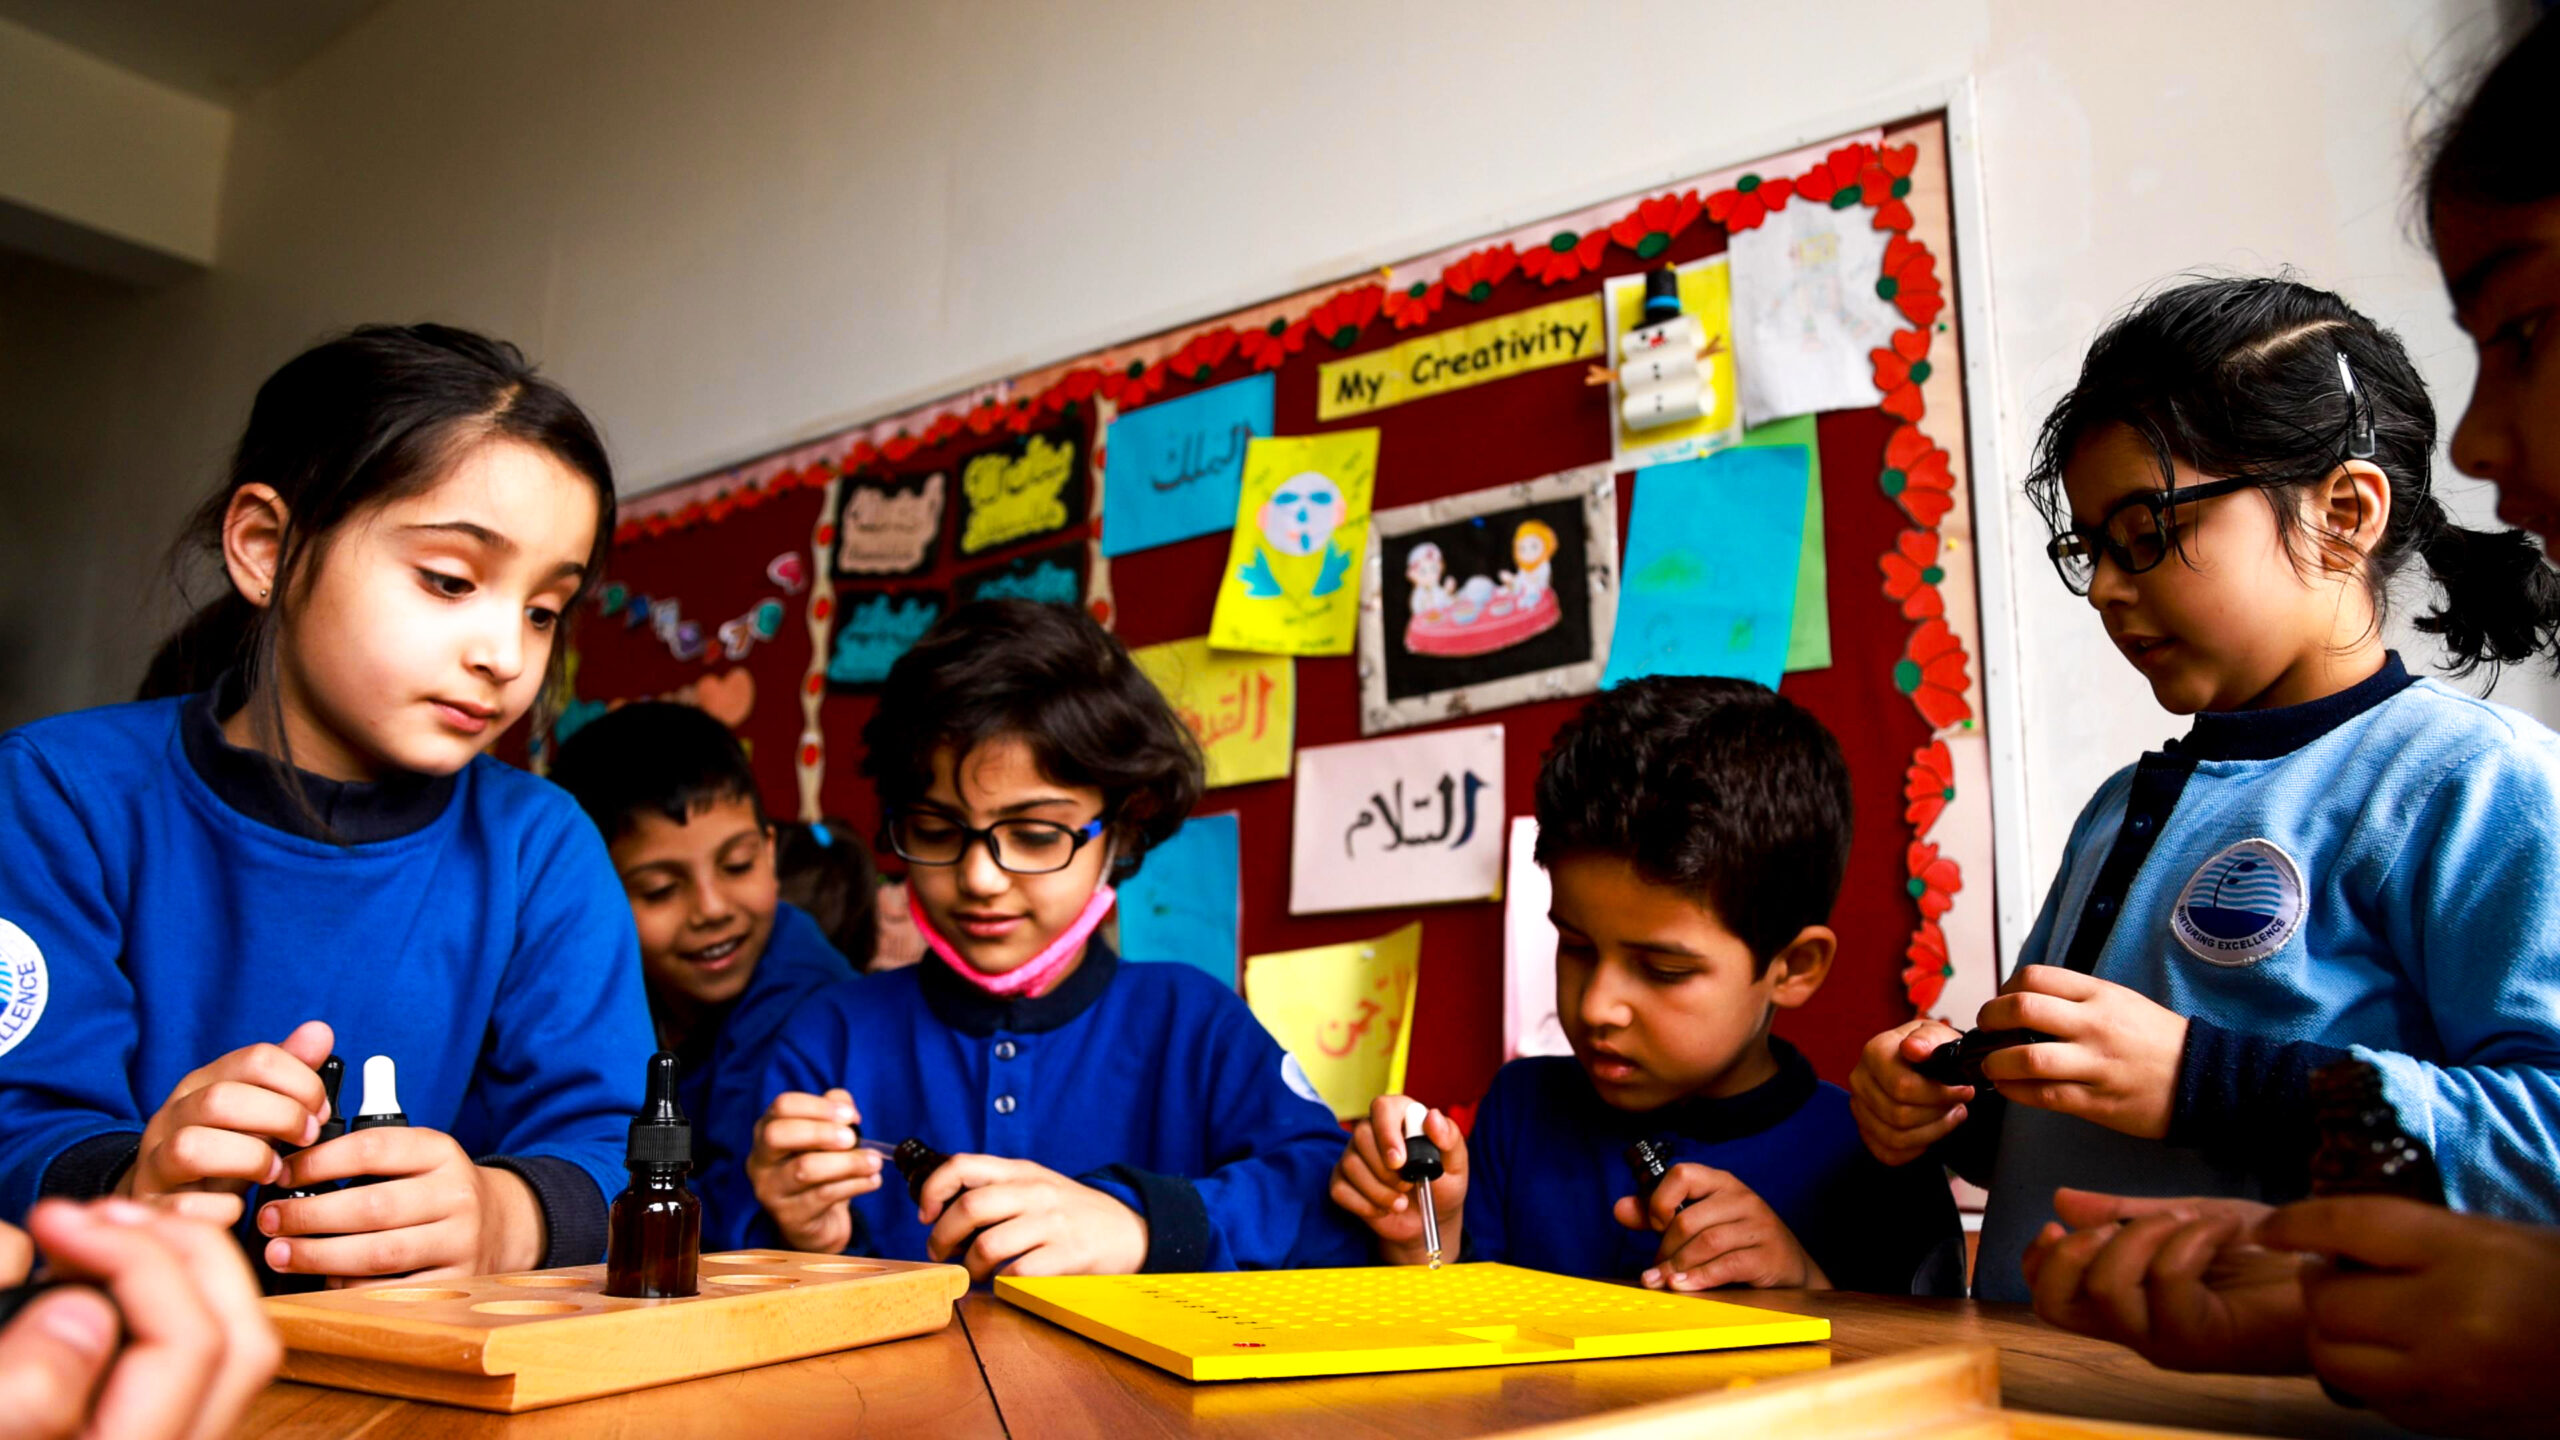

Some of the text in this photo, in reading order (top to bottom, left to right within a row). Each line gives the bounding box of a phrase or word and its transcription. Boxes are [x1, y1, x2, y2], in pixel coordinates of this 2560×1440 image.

[1335, 322, 1589, 403] My Creativity
[2177, 904, 2286, 951] NURTURING EXCELLENCE
[0, 960, 38, 1045] LLENCE
